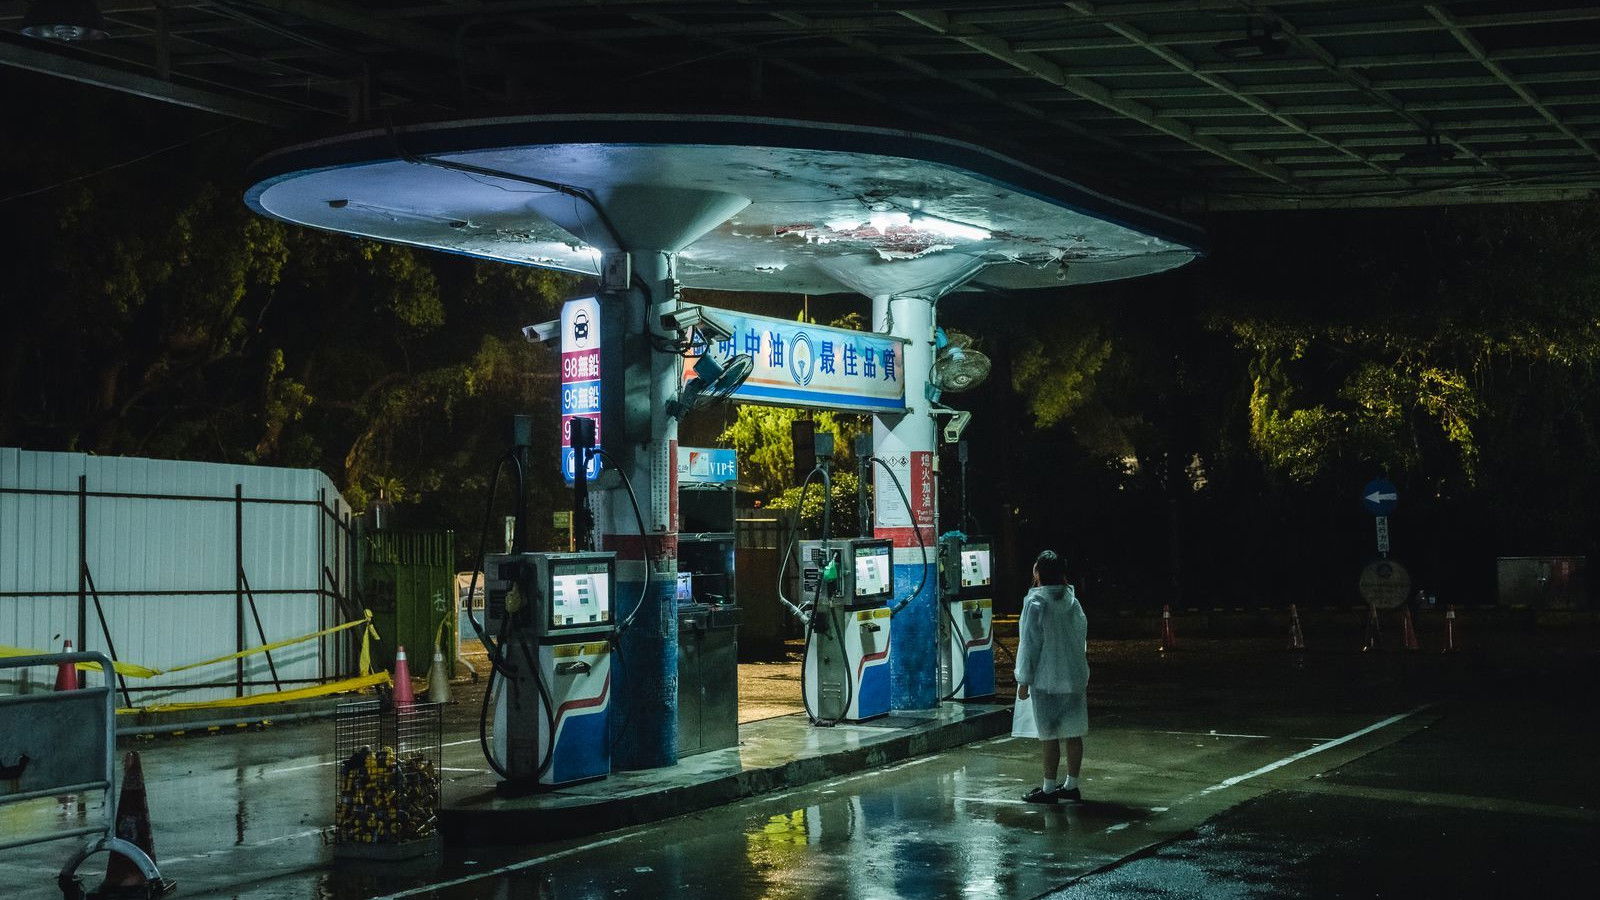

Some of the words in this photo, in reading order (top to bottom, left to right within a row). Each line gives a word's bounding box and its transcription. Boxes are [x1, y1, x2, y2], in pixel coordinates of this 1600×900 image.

[564, 355, 600, 378] 98無鉛
[819, 340, 897, 382] 最佳品質
[564, 384, 600, 409] 95無鉛
